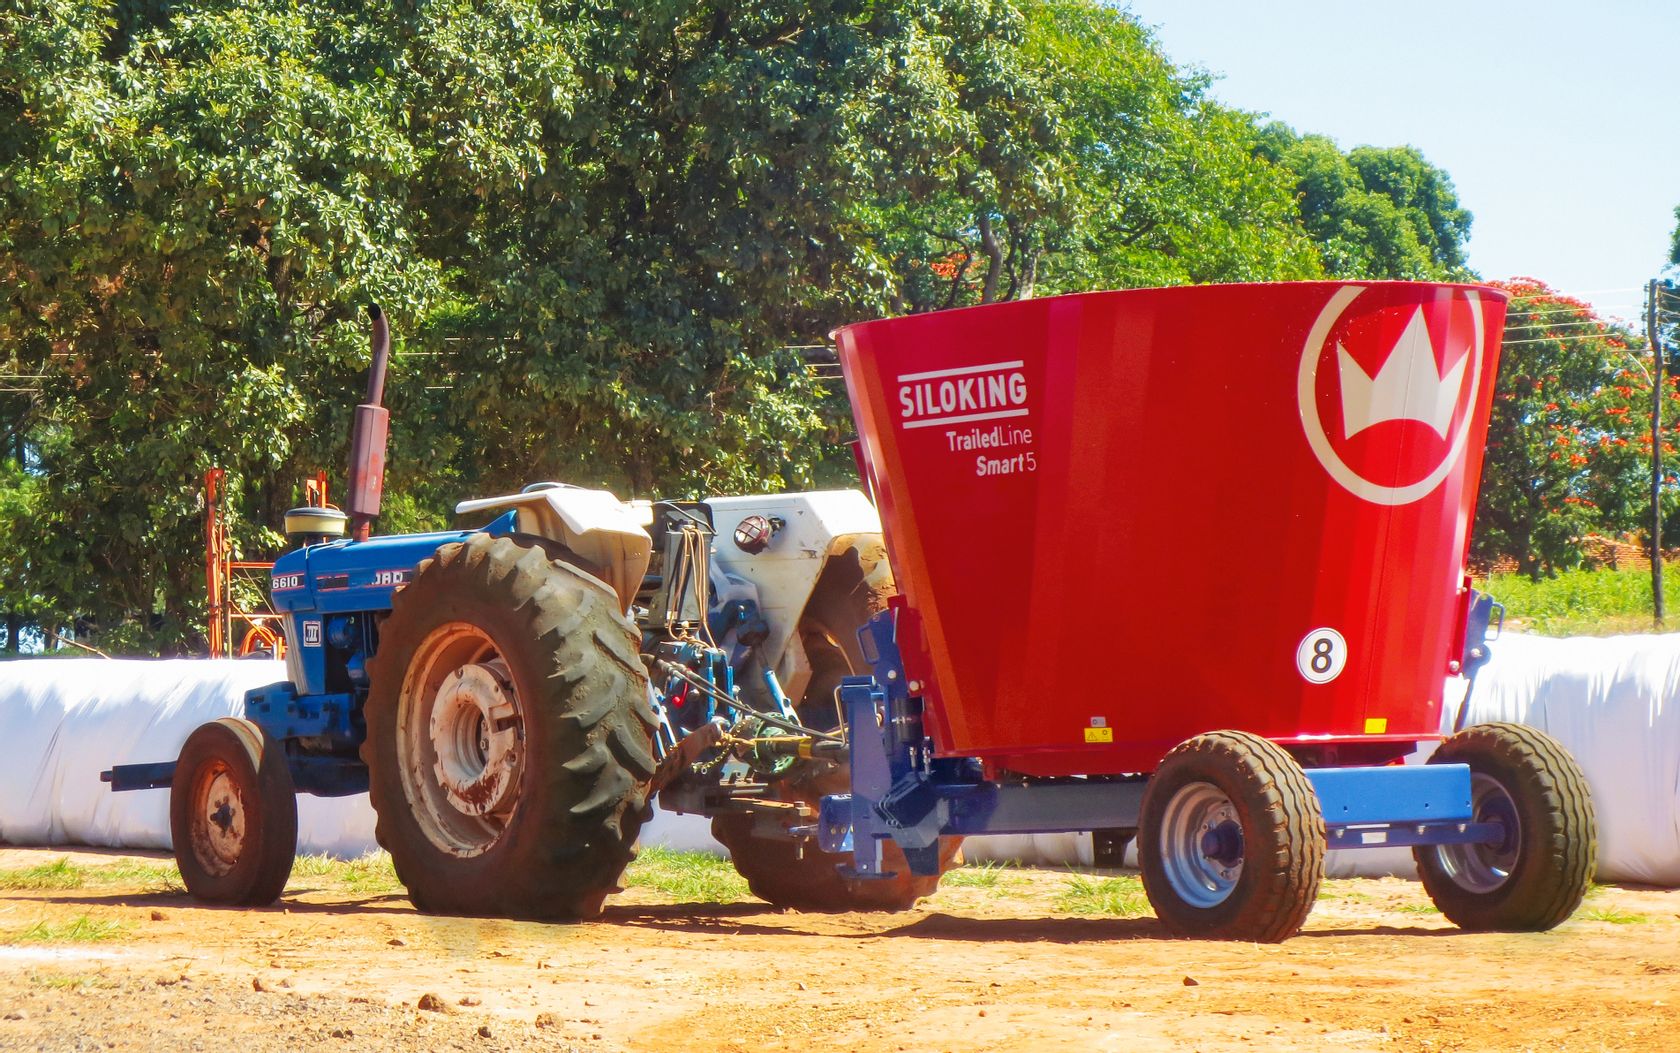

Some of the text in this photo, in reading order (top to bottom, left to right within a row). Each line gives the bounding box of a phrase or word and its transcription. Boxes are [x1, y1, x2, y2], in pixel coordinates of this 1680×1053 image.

[900, 372, 1027, 418] SILOKING
[272, 576, 298, 589] 6610
[1311, 638, 1333, 674] 8
